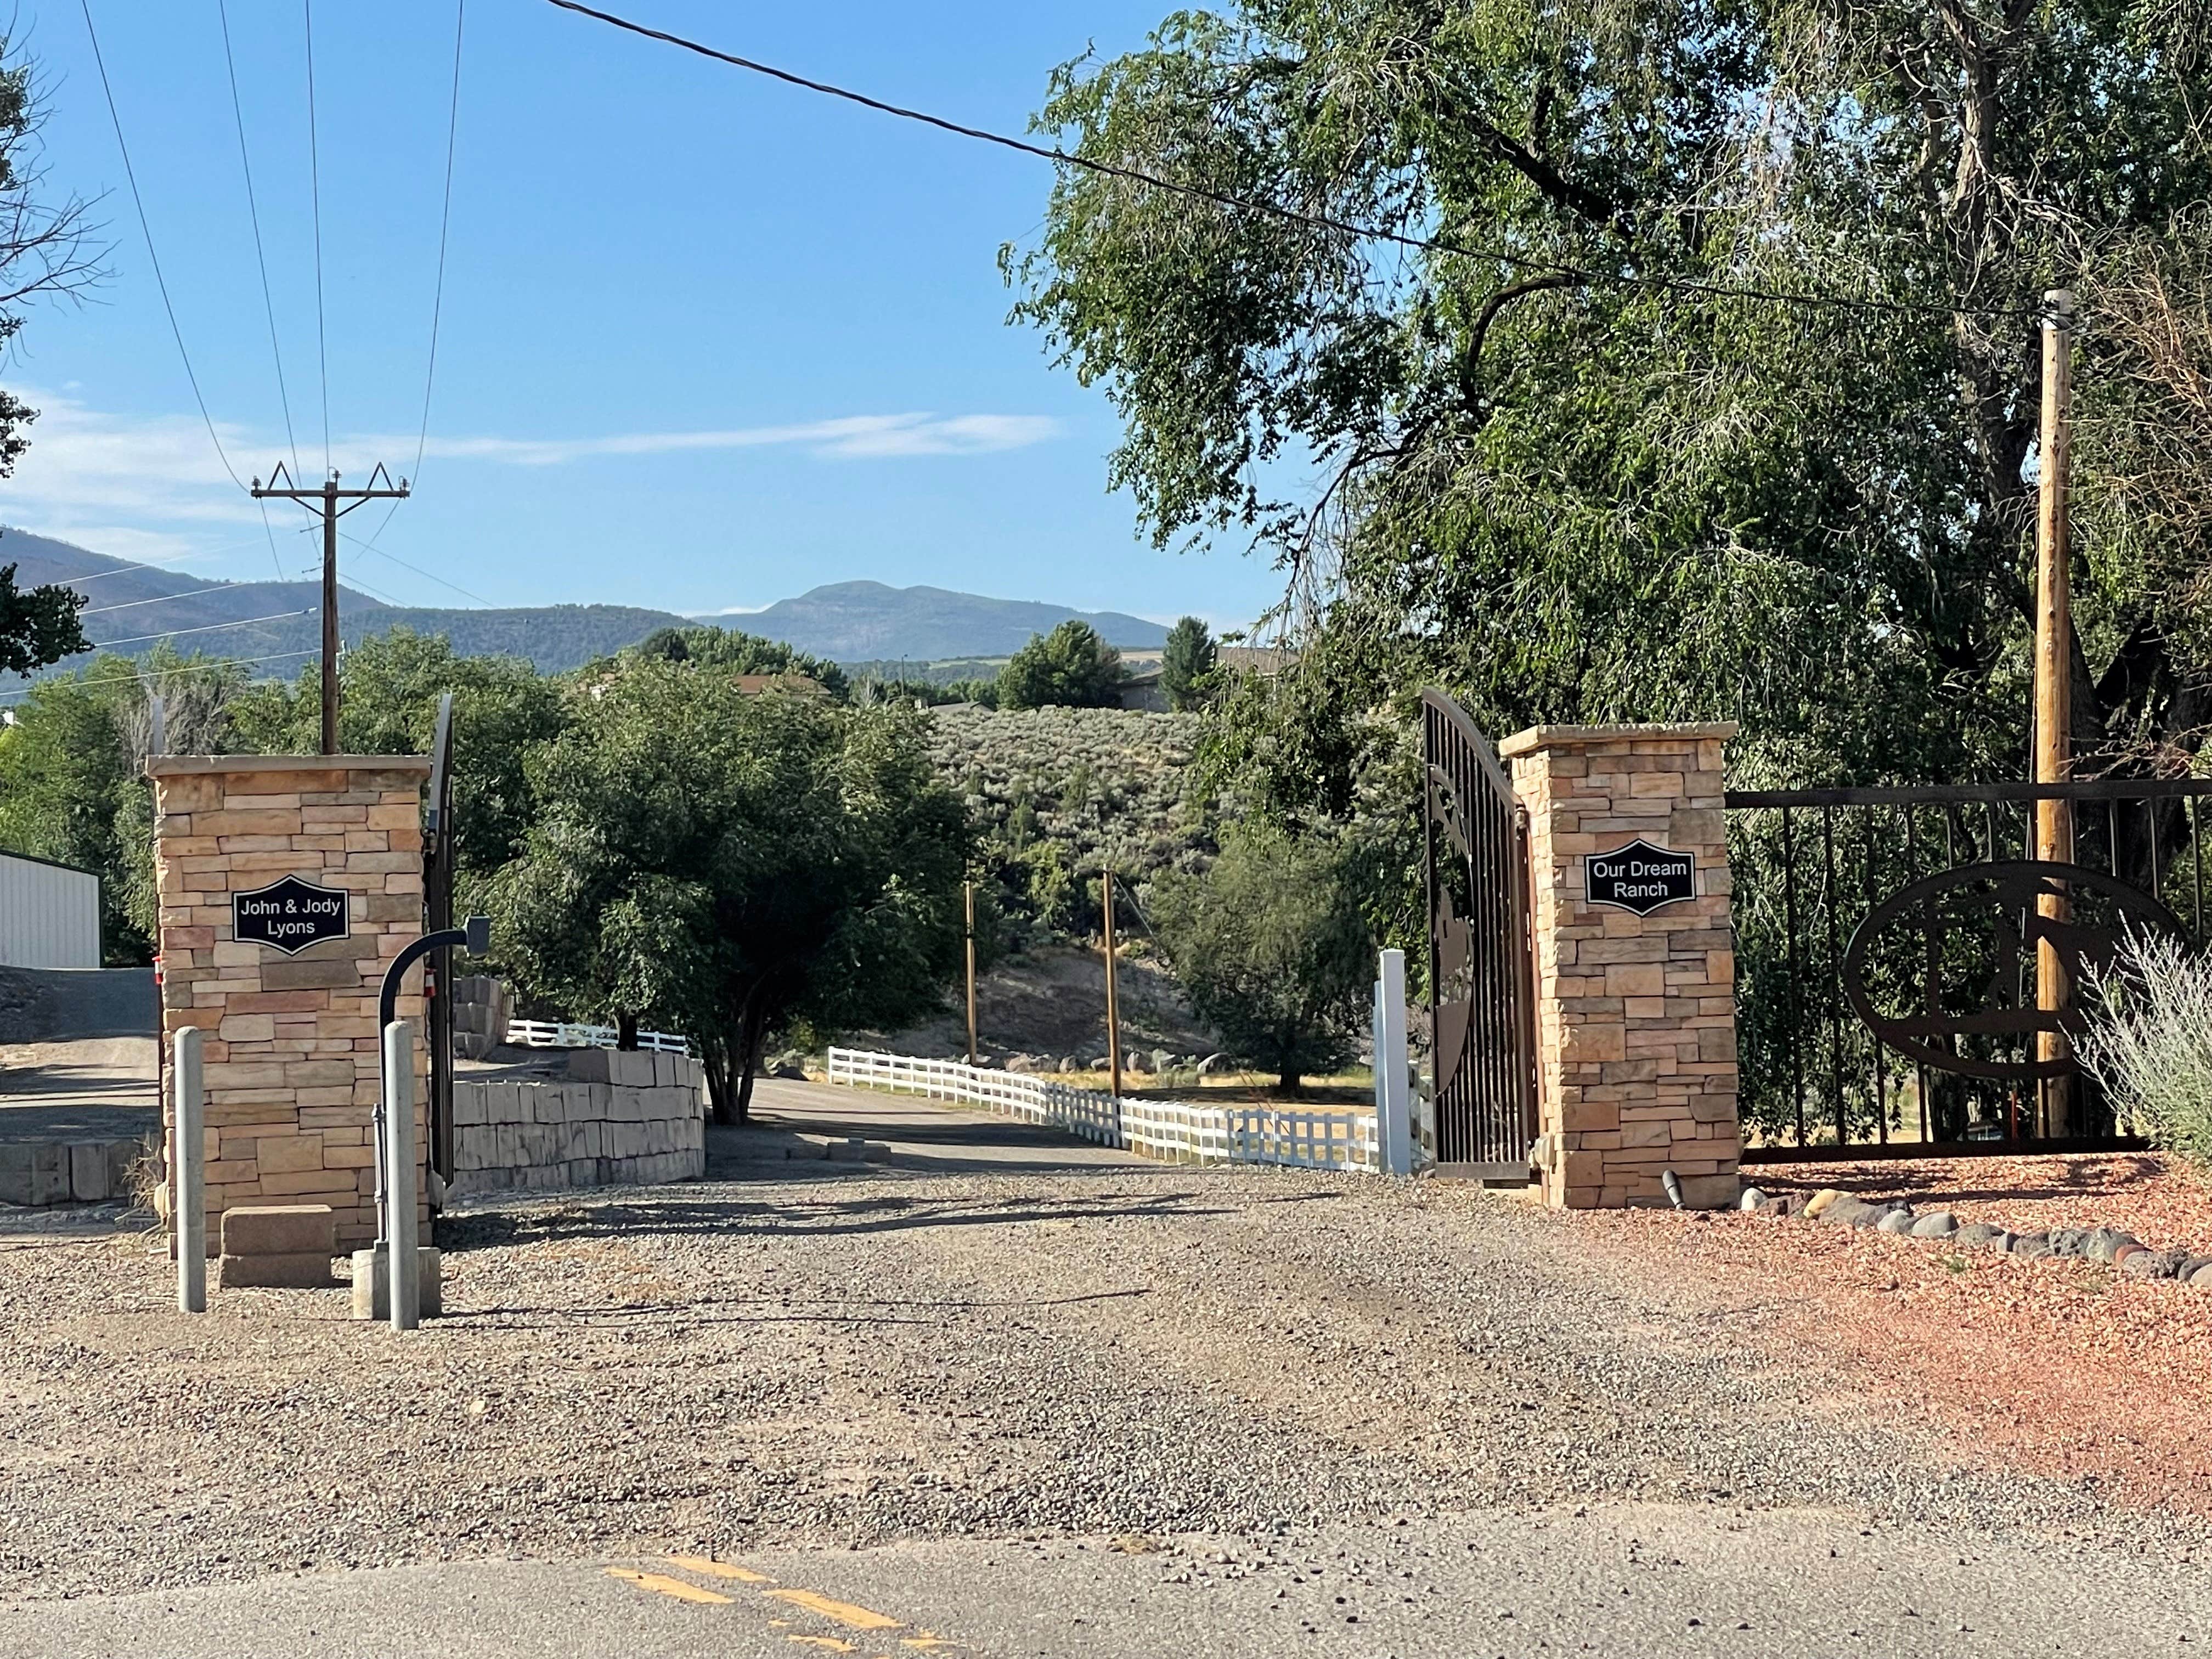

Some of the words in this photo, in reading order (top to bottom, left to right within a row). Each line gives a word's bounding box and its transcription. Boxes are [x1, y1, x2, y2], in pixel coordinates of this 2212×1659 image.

[1594, 862, 1626, 878] Our
[1630, 861, 1686, 877] Dream
[1614, 881, 1668, 898] Ranch
[241, 900, 280, 915] John
[285, 899, 297, 913] &
[302, 898, 341, 916] Jody
[268, 920, 315, 938] Lyons
